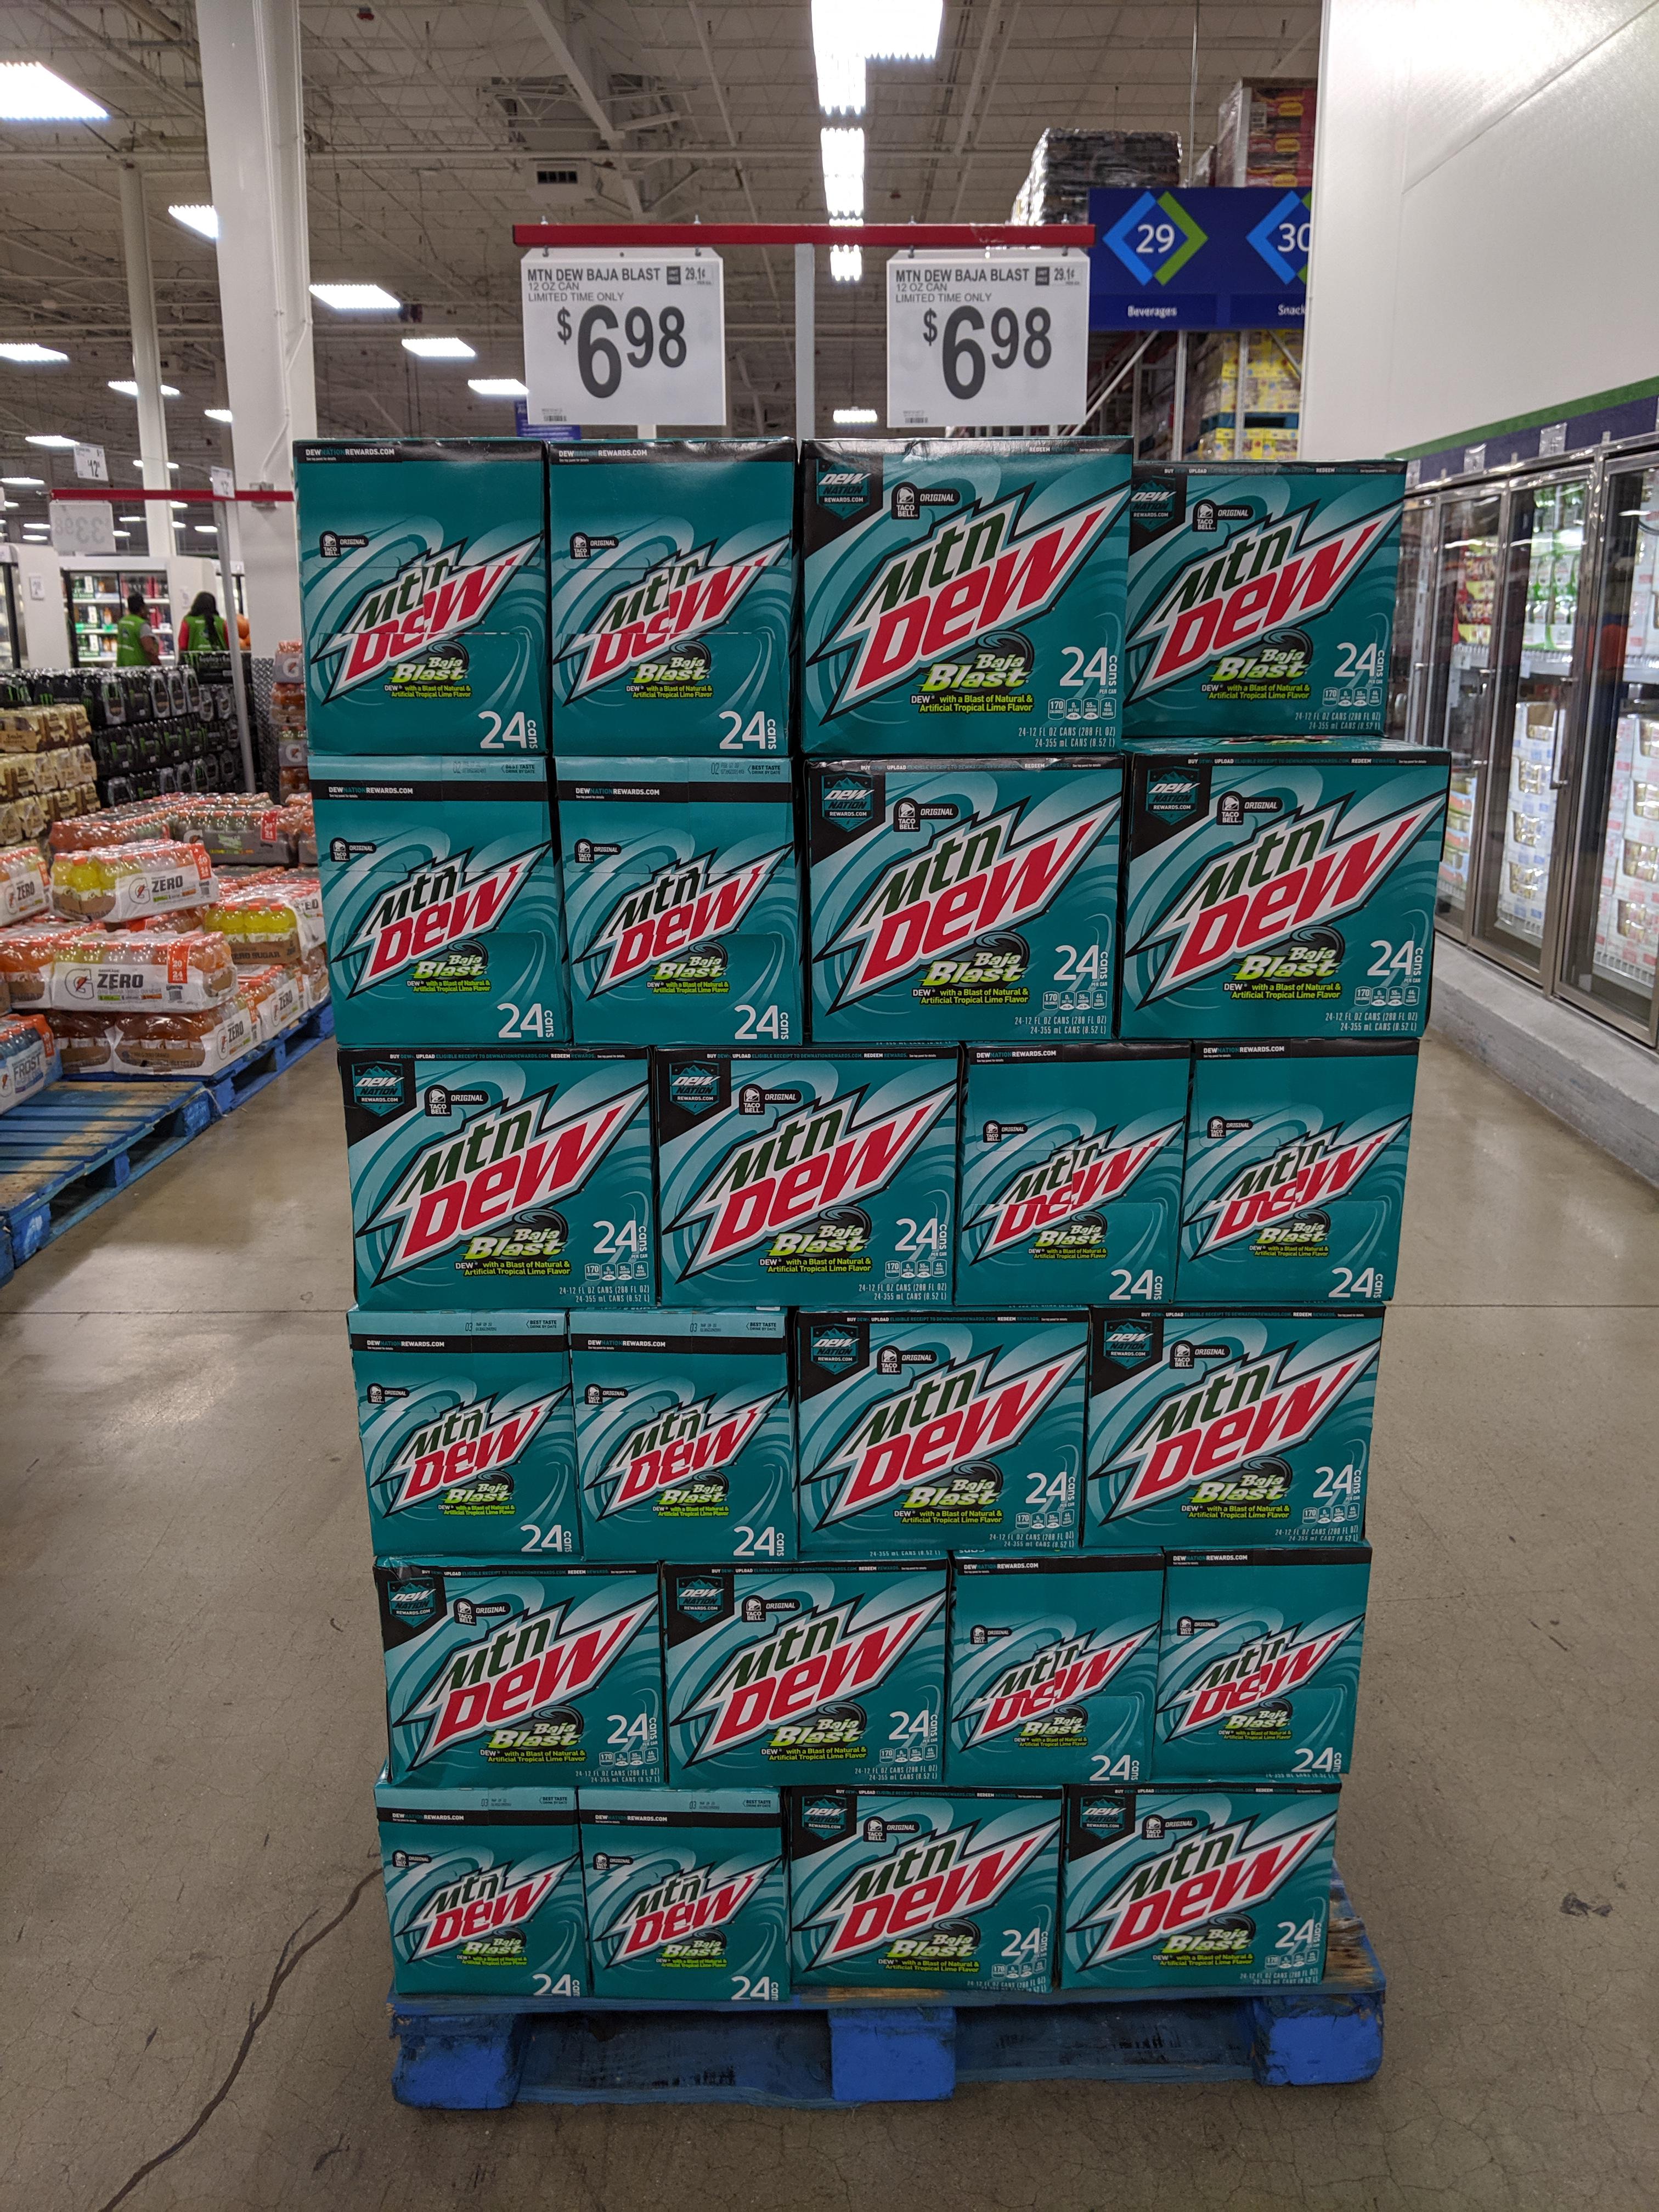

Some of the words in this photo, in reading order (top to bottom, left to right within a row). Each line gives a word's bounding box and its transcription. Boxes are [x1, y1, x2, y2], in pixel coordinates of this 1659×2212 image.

[1136, 224, 1175, 253] 29
[1277, 223, 1312, 252] 30
[528, 269, 552, 281] MTN
[556, 269, 583, 281] DEW
[586, 268, 619, 281] BAJA
[622, 268, 661, 281] BLAST
[896, 270, 921, 282] MTN
[924, 269, 952, 281] DEW
[955, 269, 987, 281] BAJA
[990, 268, 1029, 281] BLAST
[528, 292, 567, 302] LIMITED
[572, 292, 594, 302] TIME
[597, 292, 624, 301] ONLY
[529, 282, 539, 290] 12
[542, 282, 556, 290] OZ
[559, 282, 579, 290] CAN
[896, 283, 906, 291] 12
[910, 283, 923, 291] OZ
[926, 283, 947, 291] CAN
[896, 294, 935, 303] LIMITED
[939, 293, 961, 302] TIME
[964, 293, 991, 302] ONLY
[1127, 306, 1177, 318] Beverages
[920, 493, 955, 502] ORIGINAL
[977, 654, 1025, 672] Baja
[1059, 646, 1107, 686] 24
[1108, 655, 1117, 686] cans
[1334, 642, 1377, 677] 24
[921, 665, 1032, 693] Blast
[919, 704, 952, 712] Artificial
[953, 704, 984, 713] Tropical
[986, 704, 1006, 712] Lime
[1007, 704, 1032, 712] Flavor
[940, 695, 956, 703] with
[964, 695, 984, 703] Blast
[986, 695, 994, 703] of
[995, 695, 1023, 703] Natural
[1025, 695, 1033, 703] &
[478, 711, 527, 749] 24
[716, 711, 768, 749] 24
[16, 881, 35, 900] ZERO
[151, 876, 183, 893] ZERO
[1367, 940, 1414, 976] 24
[97, 974, 143, 989] ZERO
[279, 990, 294, 1010] ZERO
[228, 1021, 244, 1042] ZERO
[734, 1005, 778, 1039] 24
[591, 1220, 638, 1253] 24
[1329, 1268, 1380, 1301] 24
[1025, 1471, 1066, 1503] 24
[735, 1526, 775, 1555] 24
[605, 1713, 649, 1743] 24
[817, 1718, 859, 1731] Baja
[769, 1725, 866, 1747] Blast
[1088, 1754, 1133, 1782] 24
[1161, 1933, 1254, 1955] Blast
[1208, 1927, 1248, 1939] Baja
[1274, 1919, 1314, 1947] 24
[534, 1974, 573, 1997] 24
